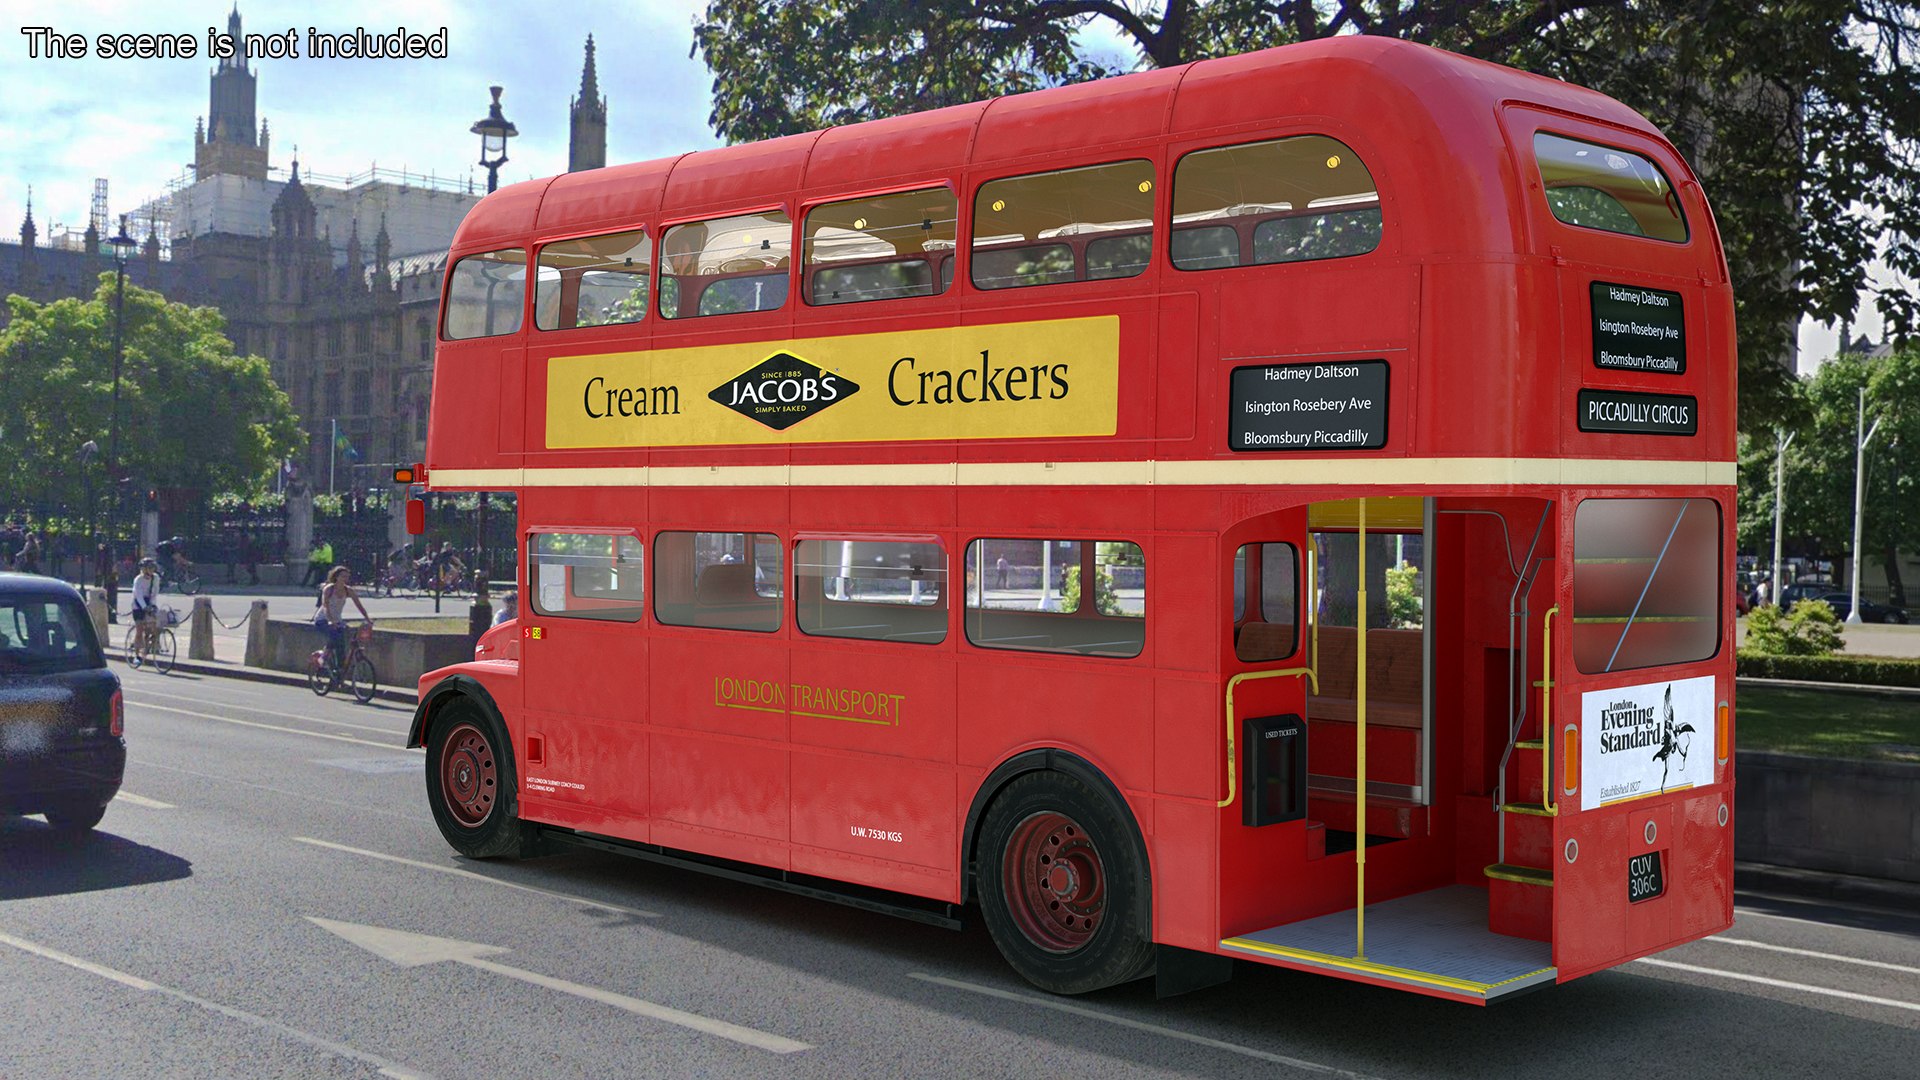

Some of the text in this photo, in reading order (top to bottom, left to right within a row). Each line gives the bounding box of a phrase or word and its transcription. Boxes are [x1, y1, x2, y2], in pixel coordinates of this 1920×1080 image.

[1610, 288, 1669, 307] Hadmey Daltson
[1631, 322, 1664, 340] Rosebery
[1665, 326, 1679, 339] Ave
[1601, 351, 1679, 371] Bloomsbury Piccadilly
[762, 370, 802, 379] SINCE 1885
[888, 350, 1069, 406] Crackers
[1265, 365, 1359, 382] Hadmey Daltson
[584, 377, 680, 418] Cream
[1245, 397, 1372, 416] Isington Rosebery Ave
[755, 406, 781, 414] SIMPLY
[1589, 401, 1688, 425] PICCADILLY CIRCUS
[1244, 429, 1368, 446] Bloomsbury Piccadilly
[715, 677, 905, 726] LONDON TRANSPORT
[1610, 699, 1632, 711] London
[1600, 703, 1654, 731] Evening
[1265, 728, 1298, 739] USED TICKETS
[1600, 722, 1661, 754] Standard
[1600, 780, 1641, 799] Established 1827
[850, 826, 902, 842] U.W. 7530 KGS
[1631, 855, 1652, 877] CUV
[1631, 874, 1657, 897] 306C
